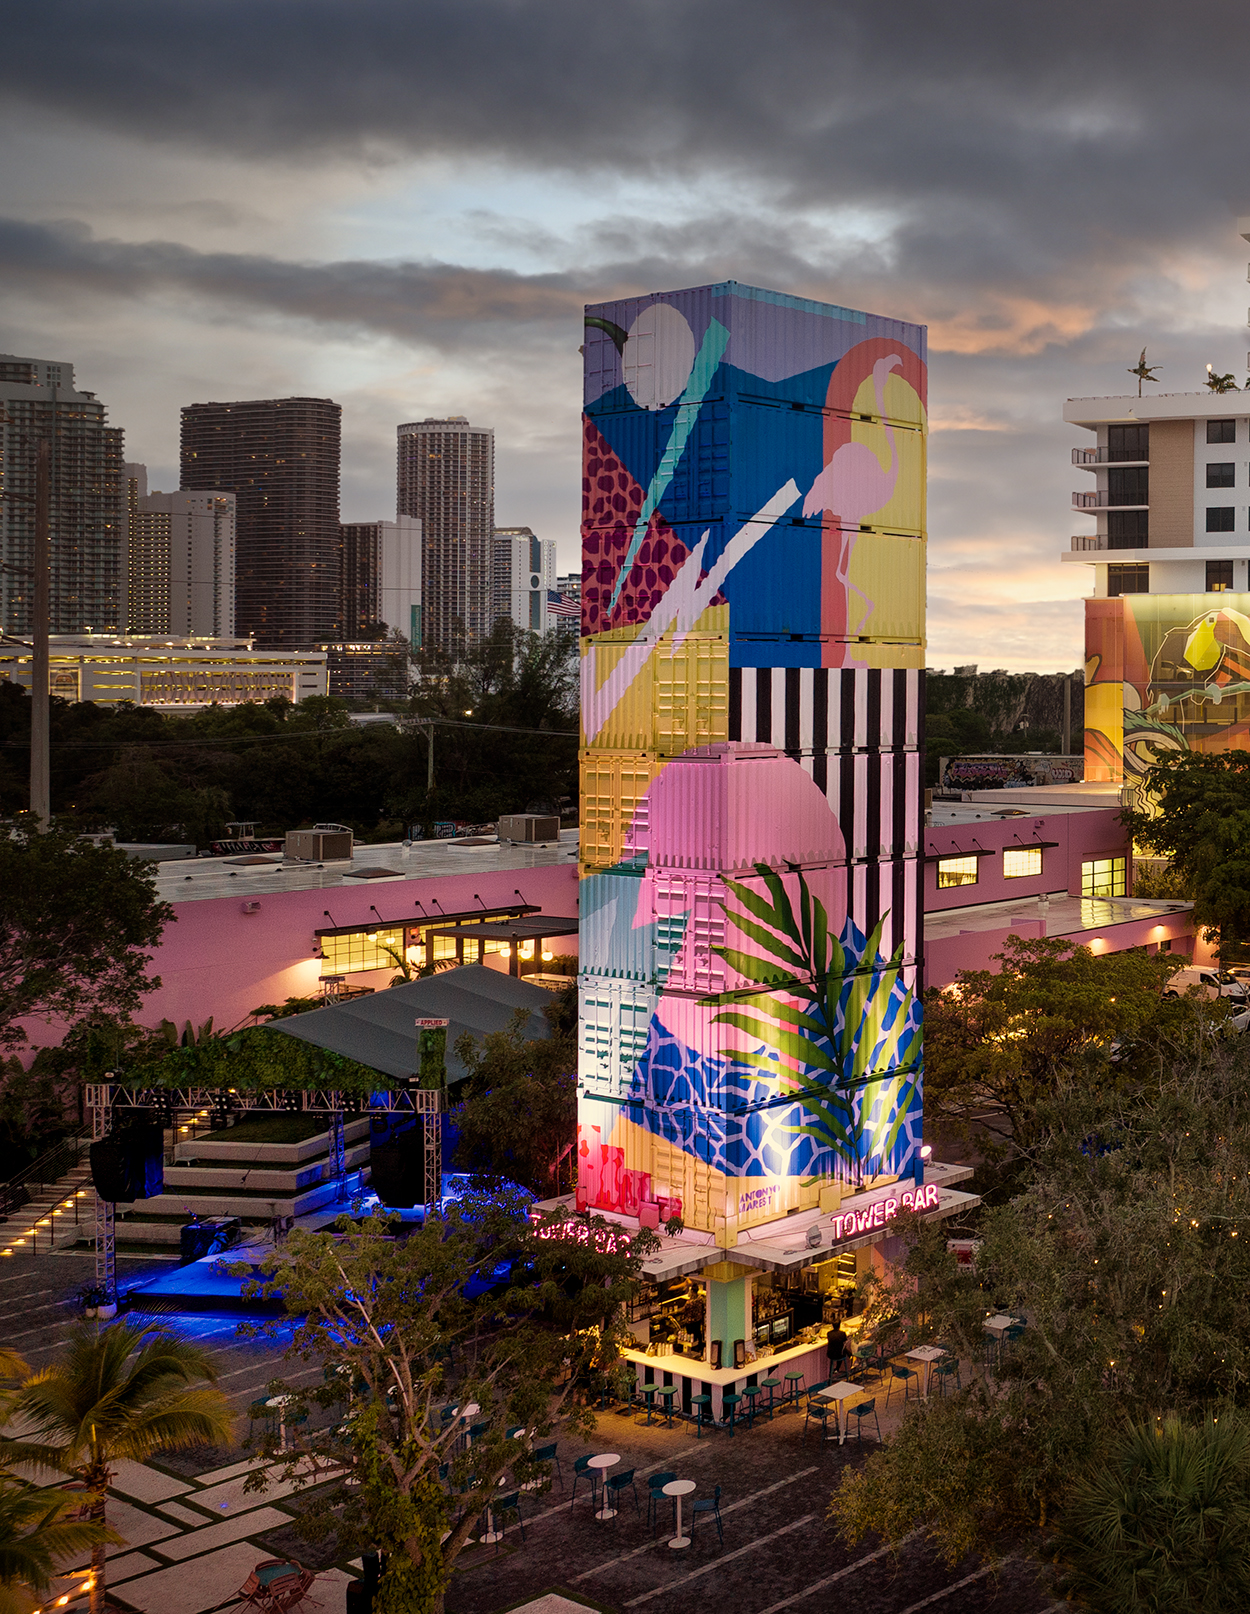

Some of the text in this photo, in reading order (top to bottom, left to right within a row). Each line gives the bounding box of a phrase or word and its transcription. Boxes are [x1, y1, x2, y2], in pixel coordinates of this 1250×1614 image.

[739, 1184, 781, 1203] ANTONYO
[831, 1184, 939, 1239] TOWER BAR
